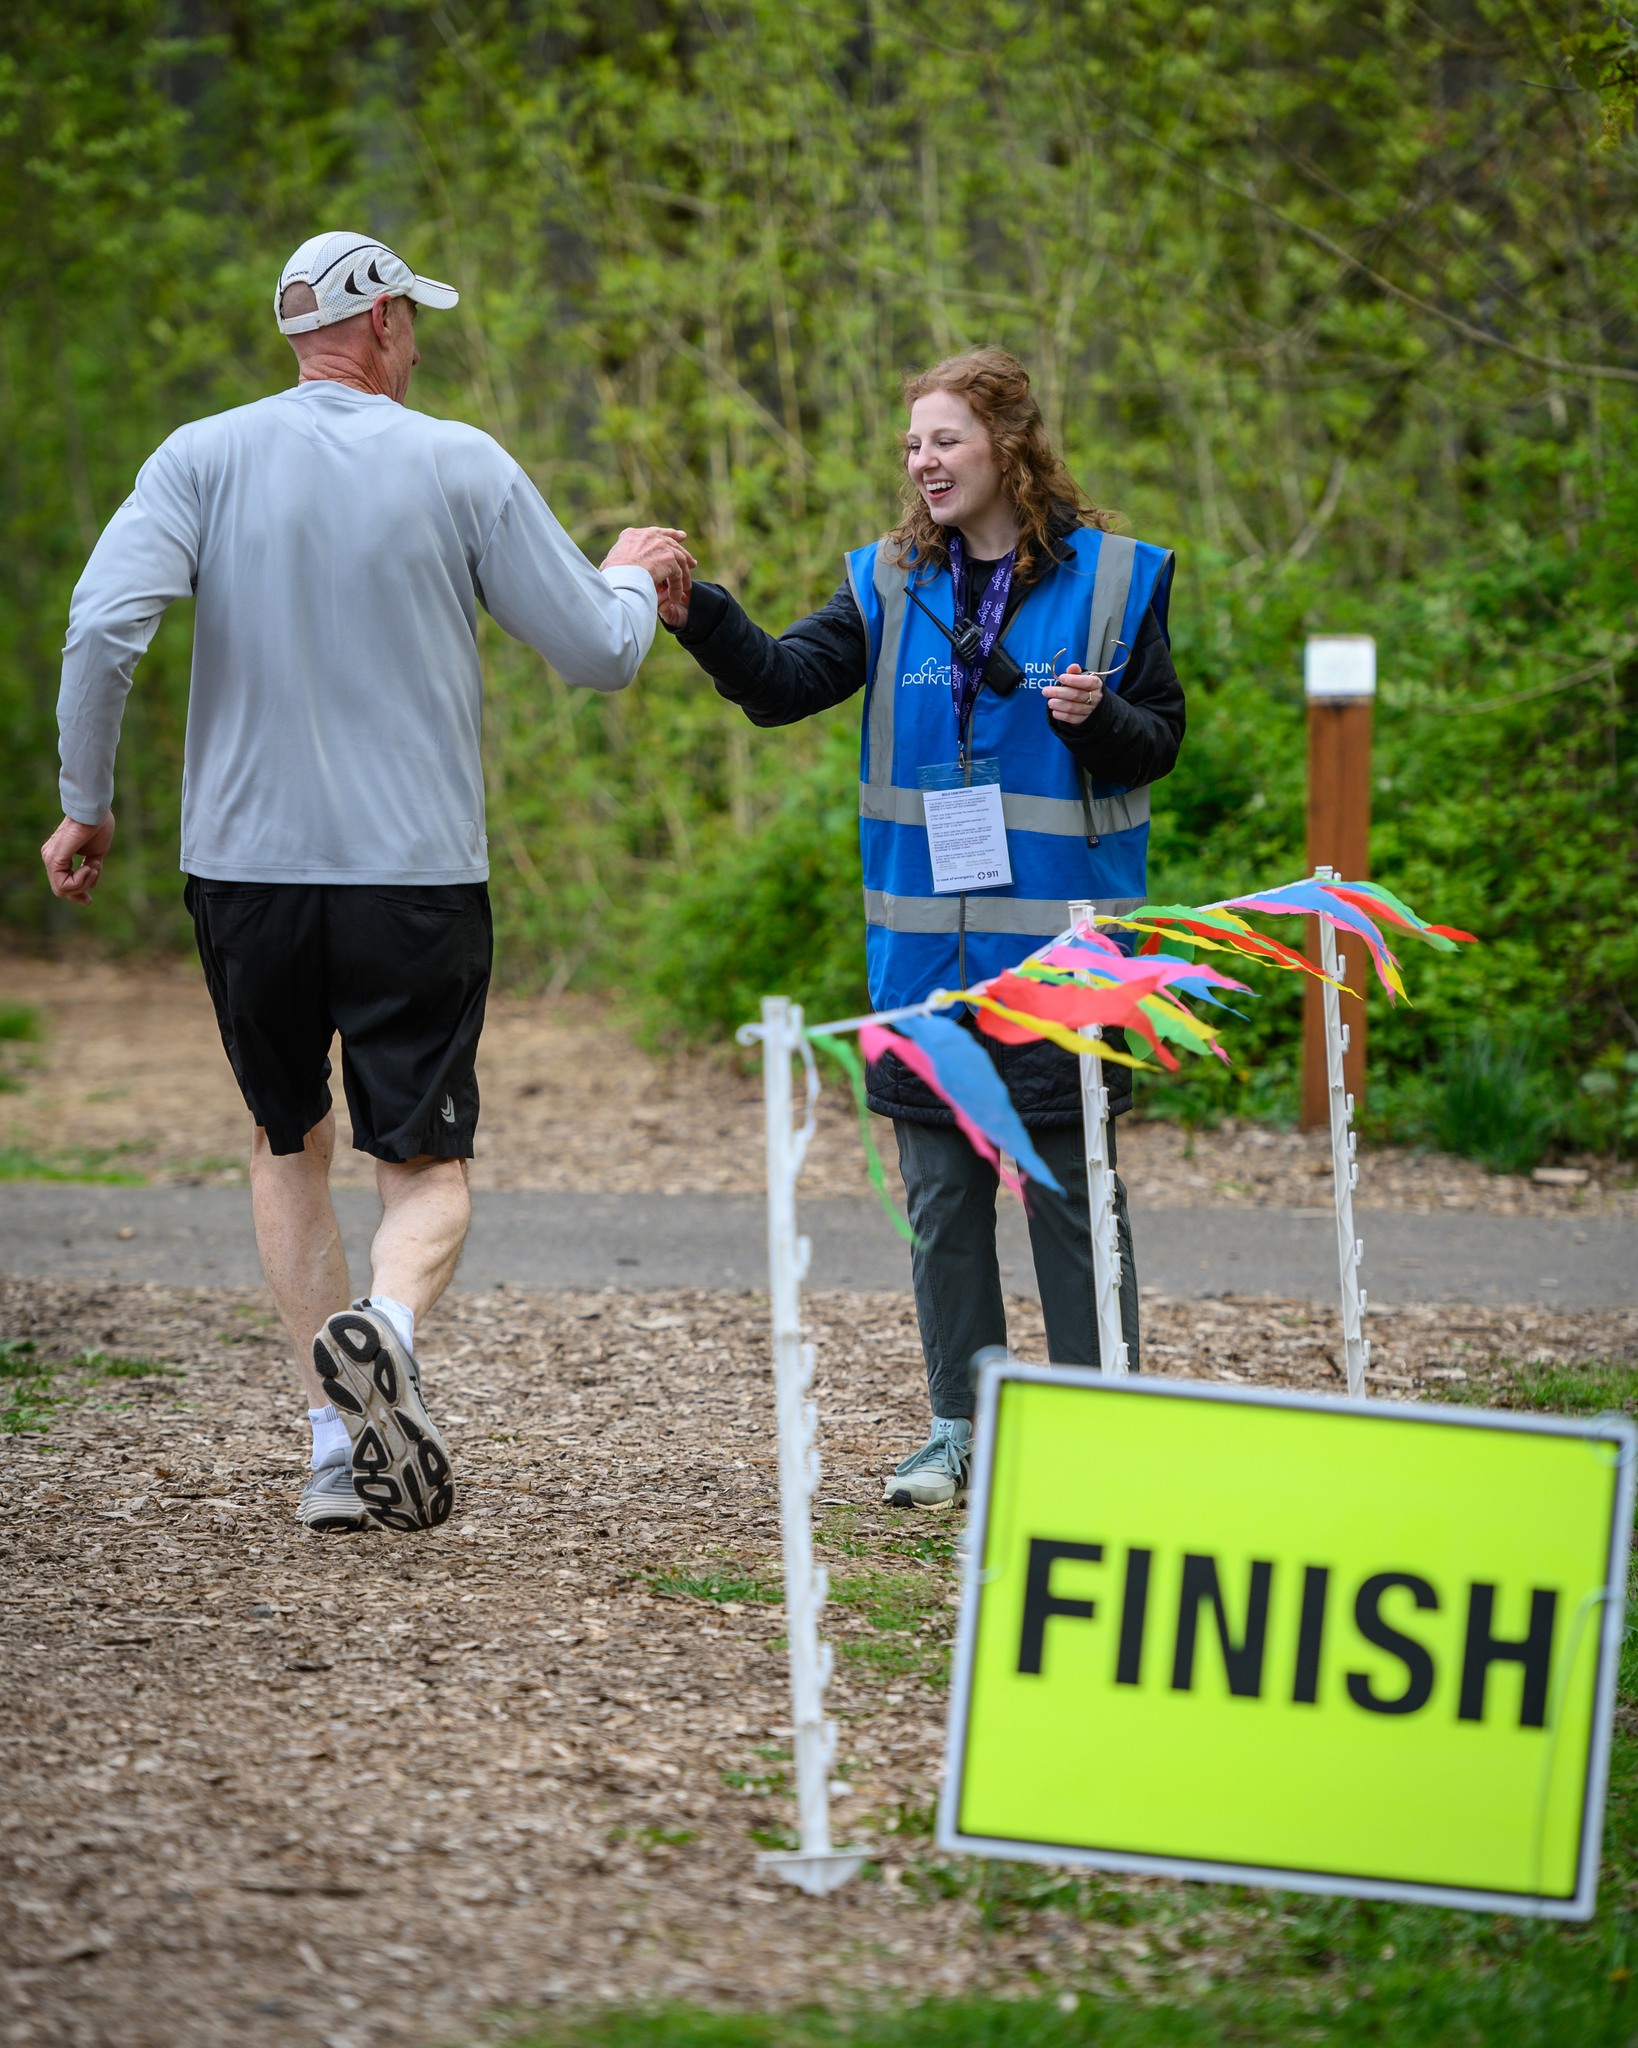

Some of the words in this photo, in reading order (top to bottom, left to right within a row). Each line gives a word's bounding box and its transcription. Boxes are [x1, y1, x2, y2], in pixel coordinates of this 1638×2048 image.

[992, 568, 1005, 590] parkrun
[977, 601, 992, 625] parkrun
[991, 603, 1004, 624] parkrun
[980, 632, 994, 657] parkrun
[902, 659, 951, 687] parkru
[952, 664, 963, 689] parkrun
[1025, 663, 1052, 674] RUN
[986, 870, 999, 878] 911
[1016, 1537, 1559, 1731] FINISH
